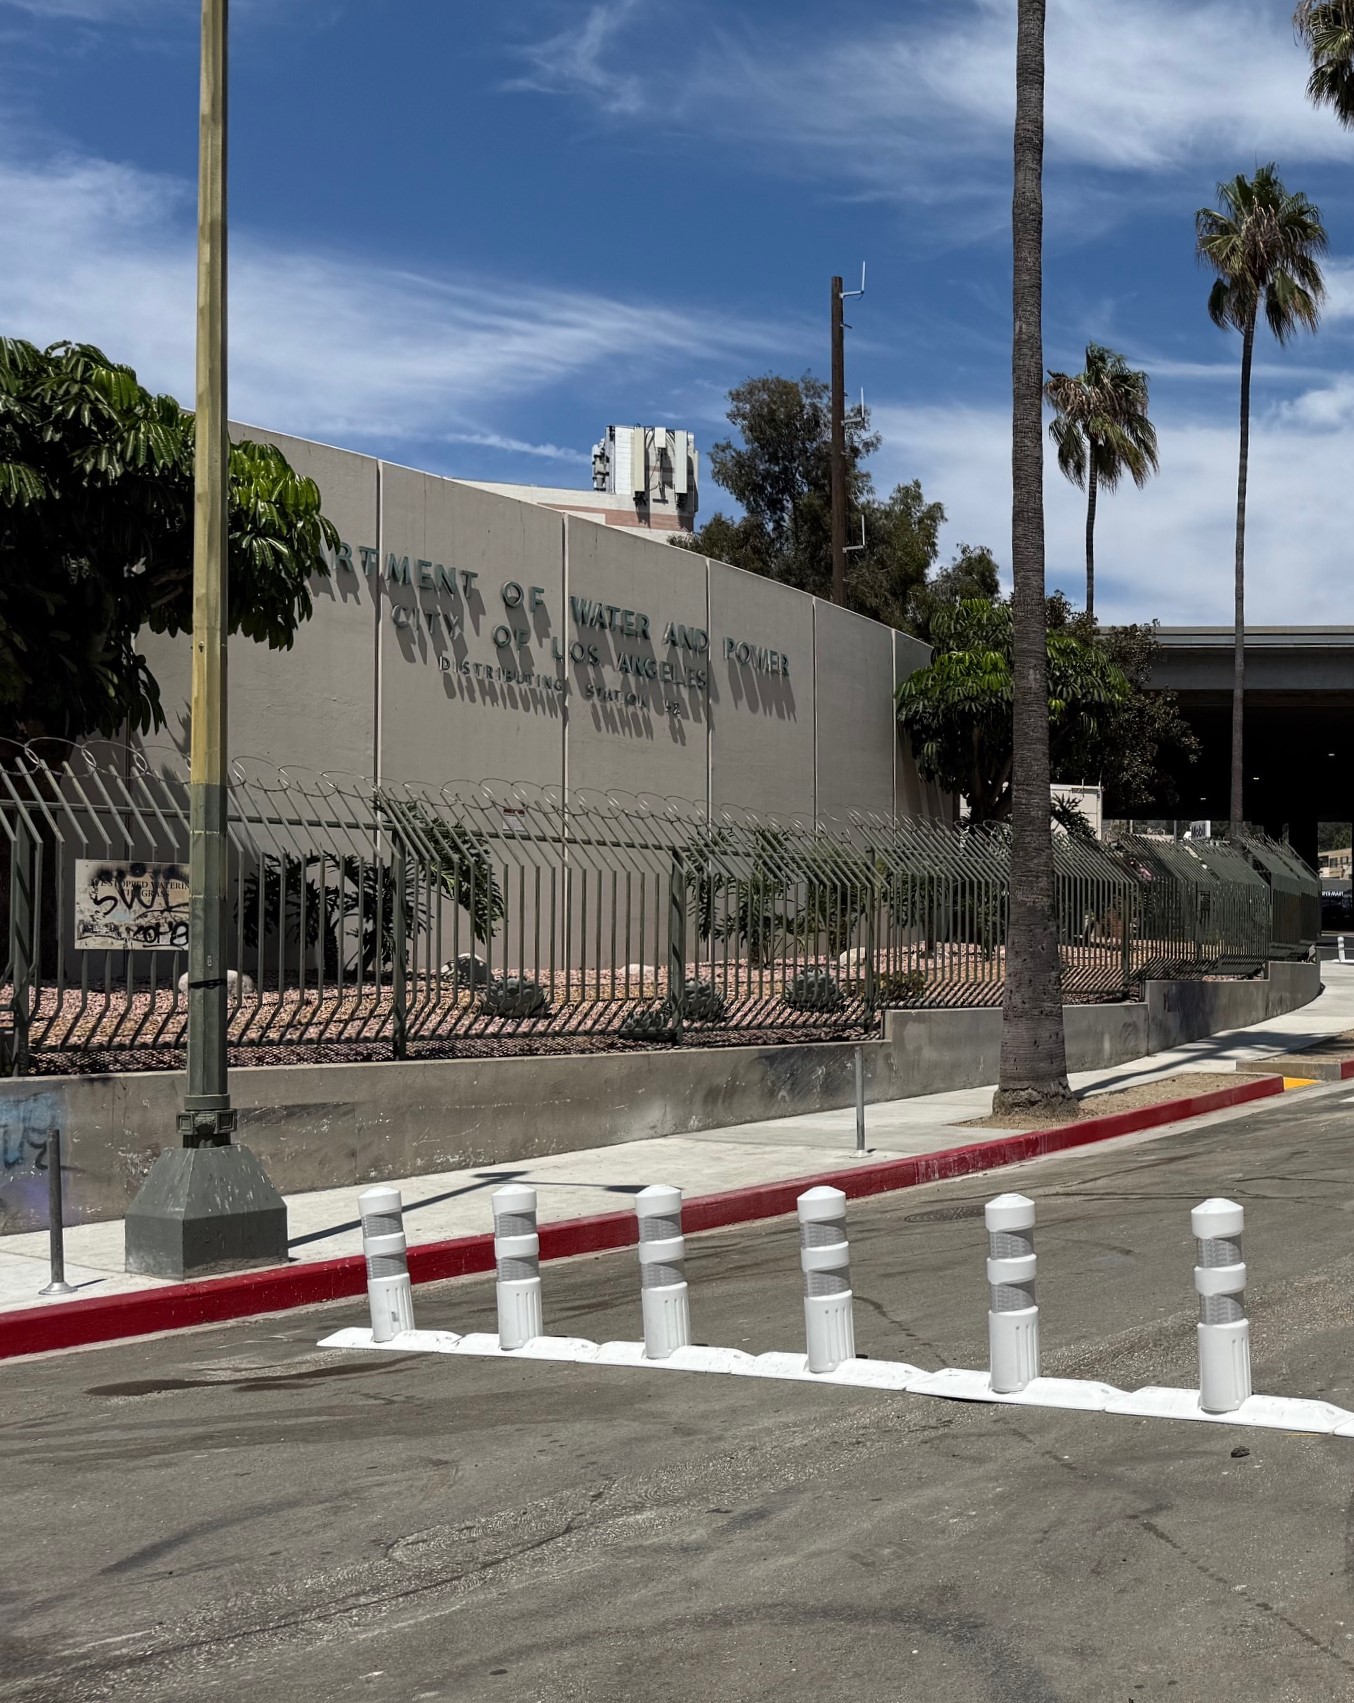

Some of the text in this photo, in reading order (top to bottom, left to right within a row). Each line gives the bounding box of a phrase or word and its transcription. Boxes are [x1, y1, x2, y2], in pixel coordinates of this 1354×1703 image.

[320, 541, 790, 677] RTMENT OF WATER AND POWER
[391, 604, 707, 690] CITY OF LOS ANGELES
[439, 656, 563, 692] DISTRIBUTING
[586, 683, 648, 708] STATION
